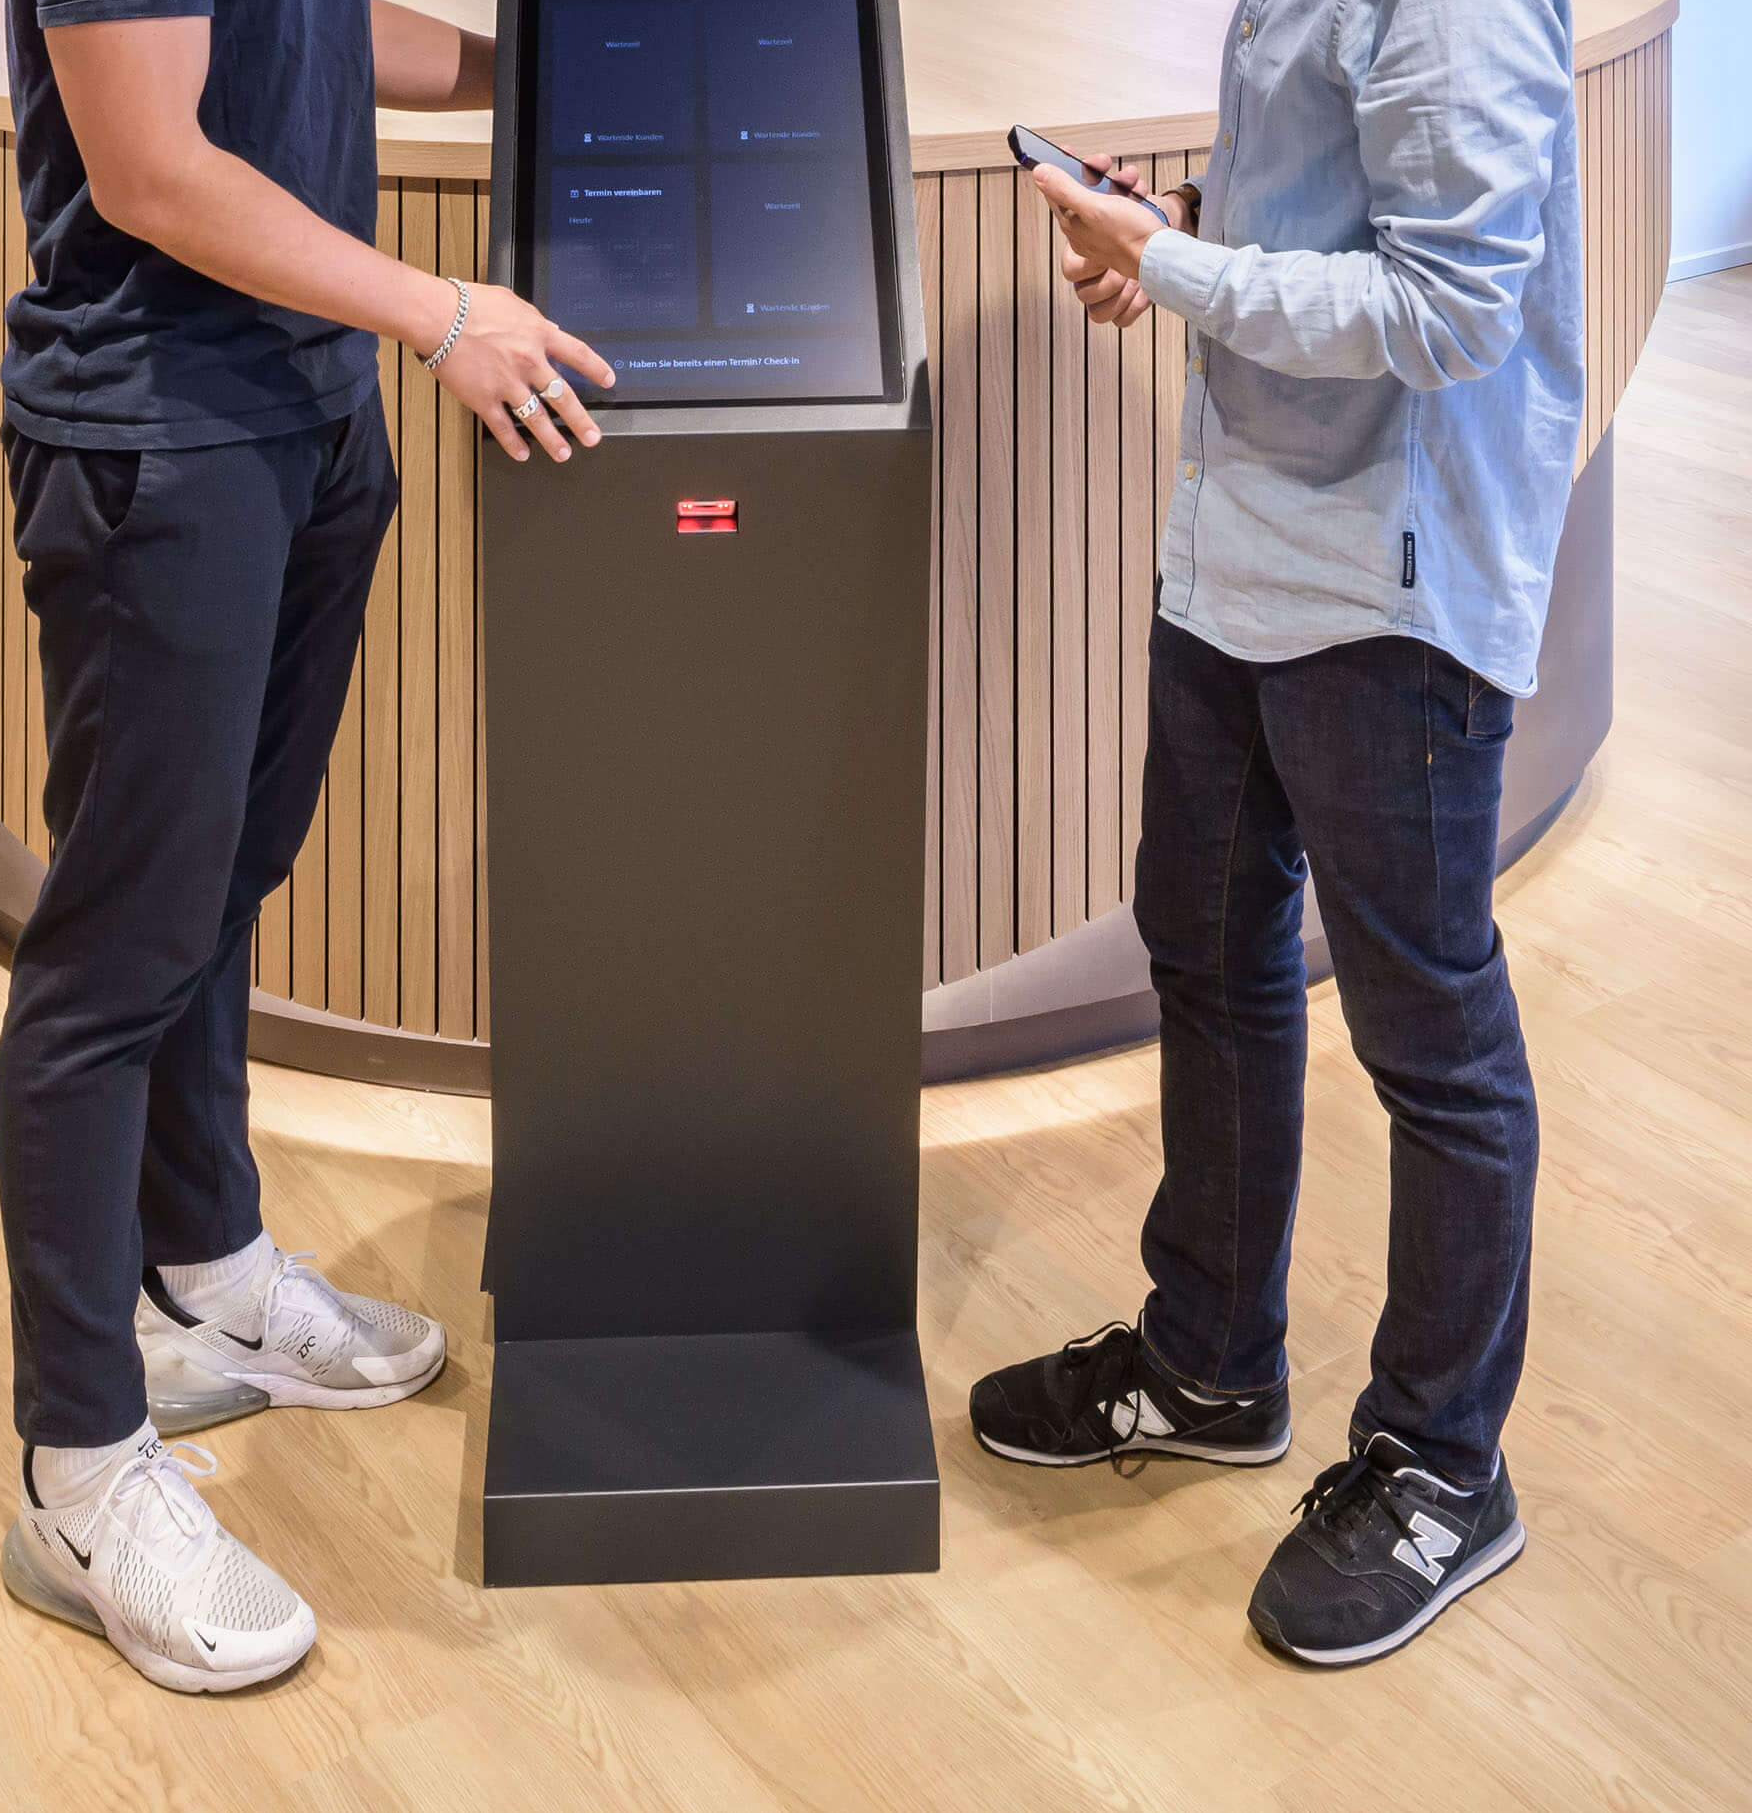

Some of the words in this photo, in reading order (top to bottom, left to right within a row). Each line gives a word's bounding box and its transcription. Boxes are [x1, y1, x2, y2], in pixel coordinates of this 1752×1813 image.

[584, 188, 613, 197] Termin
[613, 188, 662, 197] vereinbaren
[629, 360, 657, 369] Haben
[658, 359, 672, 368] Sie
[673, 358, 703, 368] bereits
[703, 359, 727, 367] einen
[728, 357, 762, 367] Termin?
